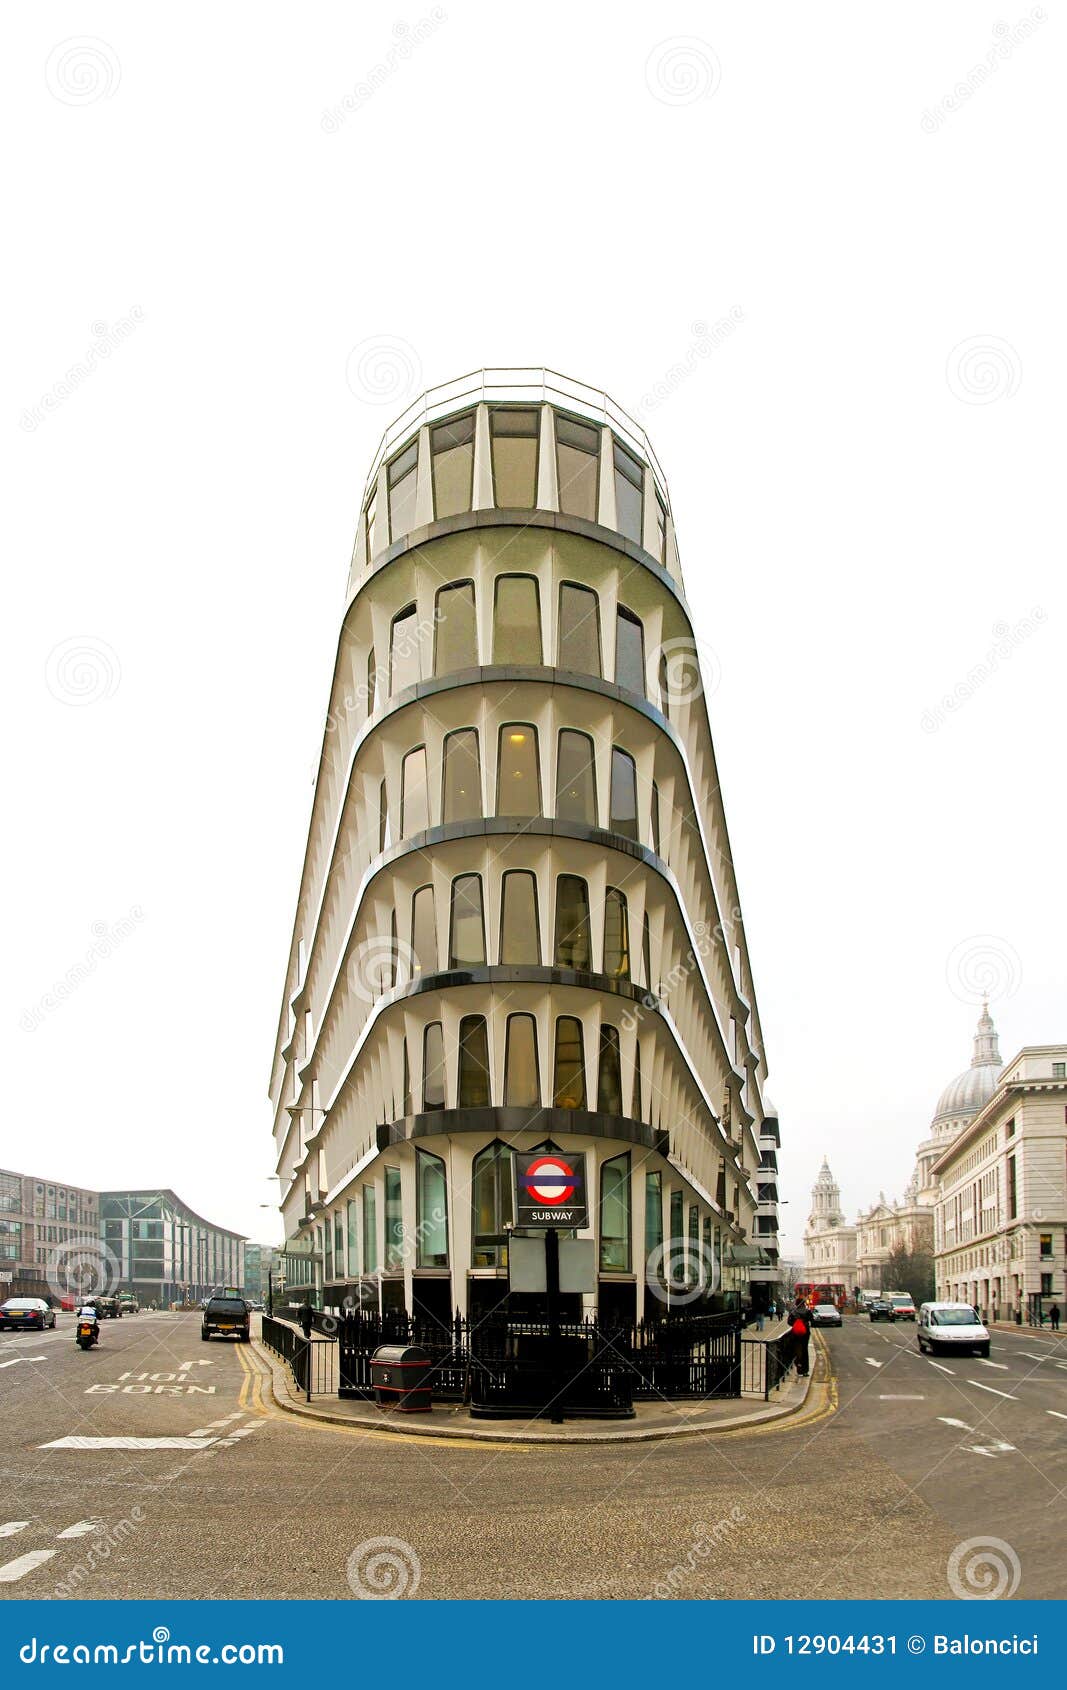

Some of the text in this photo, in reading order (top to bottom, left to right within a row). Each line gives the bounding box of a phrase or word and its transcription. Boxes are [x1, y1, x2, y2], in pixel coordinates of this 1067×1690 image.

[531, 1211, 573, 1221] SUBWAY
[118, 1372, 201, 1382] HOL
[83, 1384, 217, 1395] BORN
